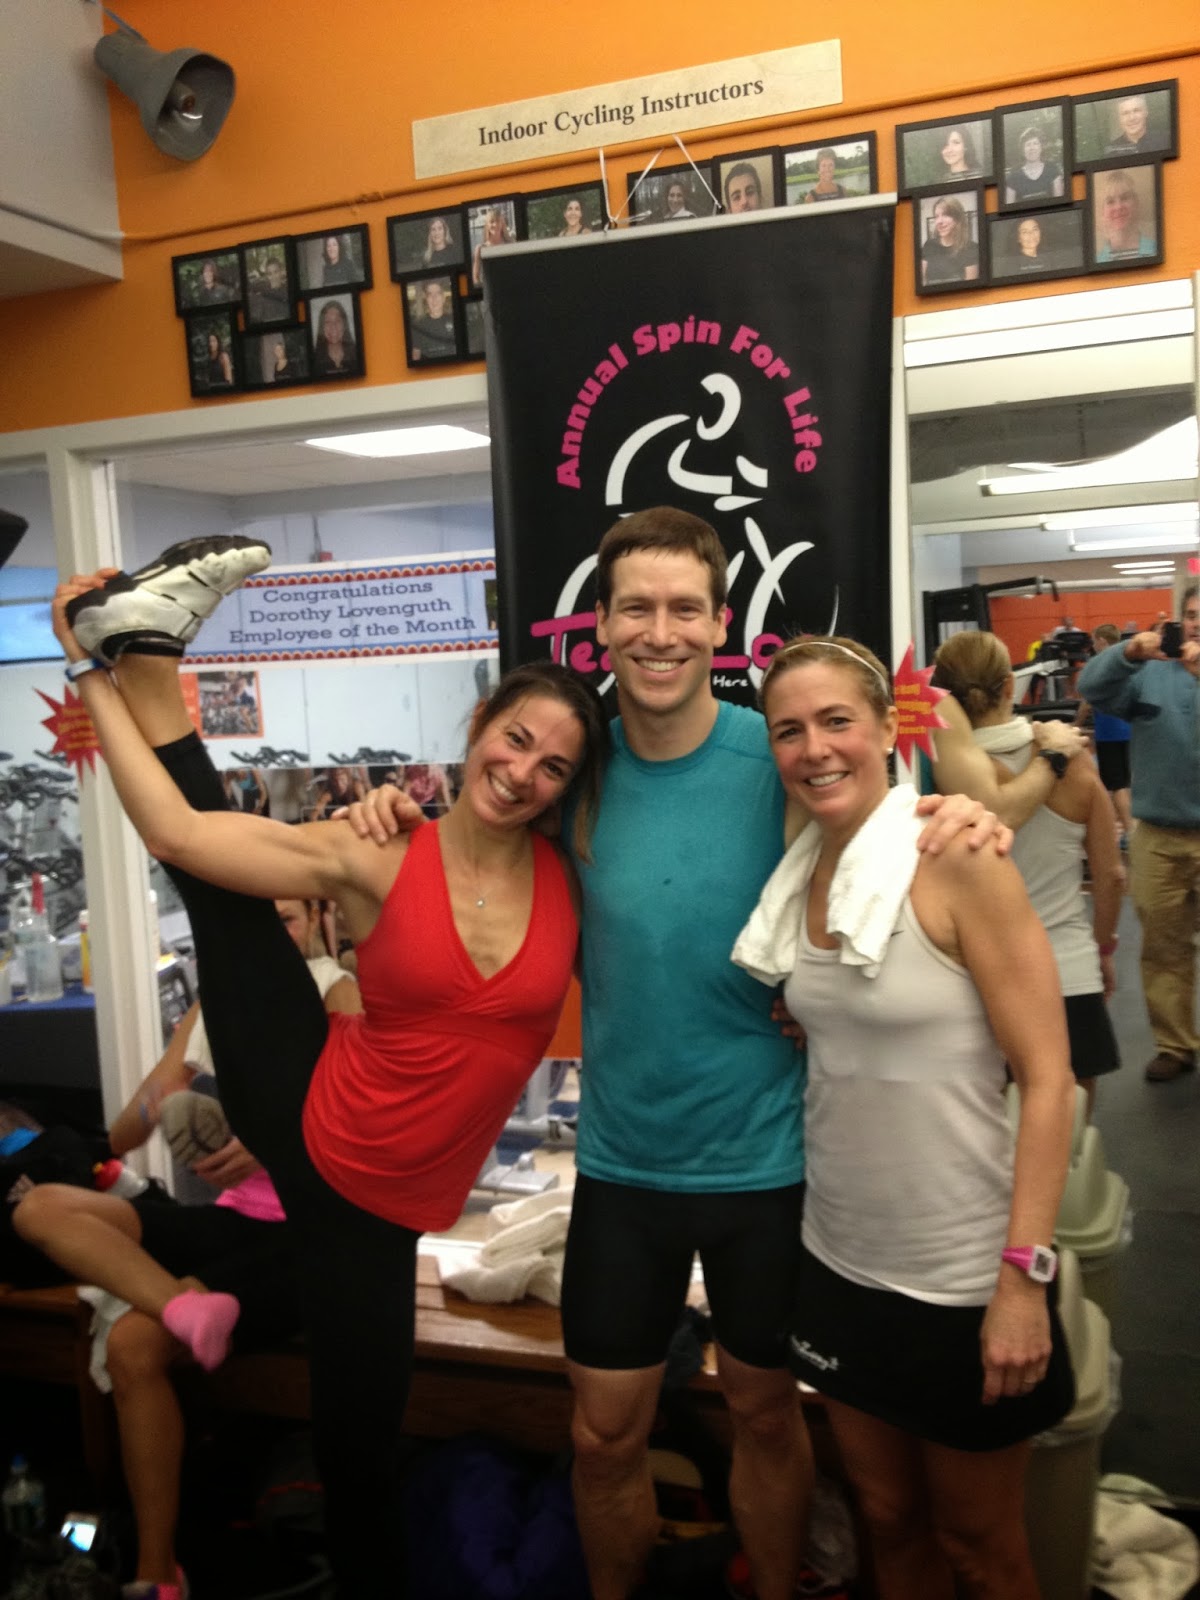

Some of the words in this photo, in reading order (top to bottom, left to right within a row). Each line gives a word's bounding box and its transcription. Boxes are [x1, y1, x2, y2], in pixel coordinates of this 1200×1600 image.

[478, 118, 548, 147] Indoor
[554, 101, 635, 132] Cycling
[641, 79, 764, 117] Instructors
[557, 344, 629, 489] Annual
[632, 315, 722, 356] Spin
[729, 325, 792, 379] For
[784, 387, 823, 473] Life
[262, 582, 433, 604] Congratulations
[249, 607, 332, 623] Dorothy
[337, 598, 452, 618] Lovenguth
[229, 628, 333, 646] Employee
[339, 623, 361, 638] of
[366, 622, 400, 637] the
[405, 616, 476, 634] Month
[712, 675, 749, 688] Here
